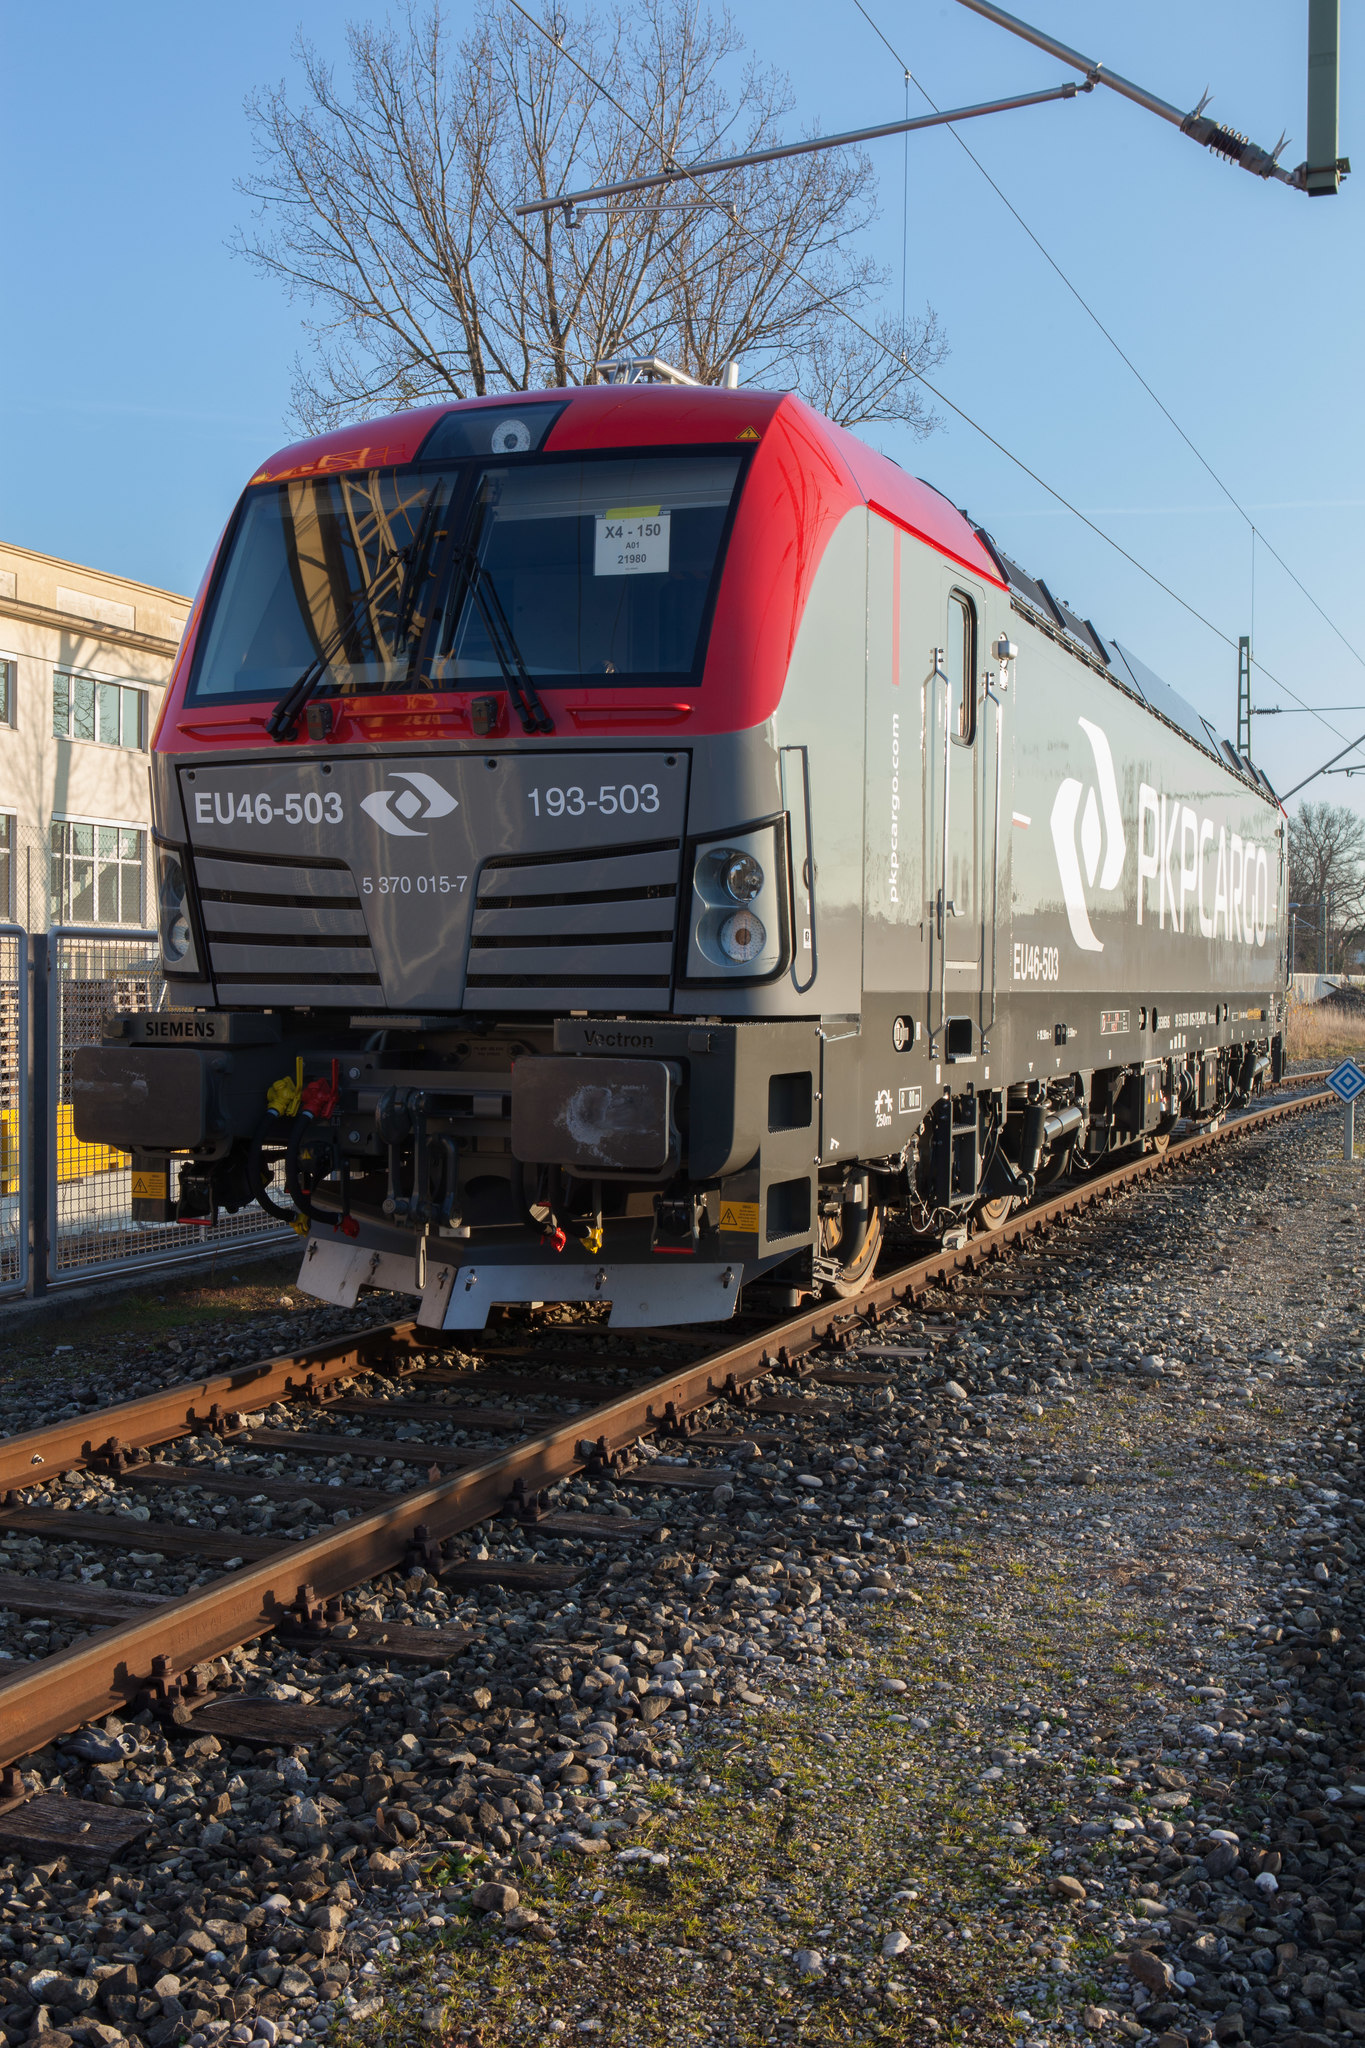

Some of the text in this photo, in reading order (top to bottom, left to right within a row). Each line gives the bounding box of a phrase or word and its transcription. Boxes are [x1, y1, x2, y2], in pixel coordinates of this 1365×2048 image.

[605, 526, 623, 539] X4
[637, 523, 661, 537] 150
[625, 541, 640, 550] A01
[617, 553, 647, 564] 21980
[194, 792, 344, 825] EU46-503
[528, 783, 660, 817] 193-503
[888, 713, 900, 903] pkpcargo.com
[362, 875, 468, 894] 5 370 015-7
[1013, 942, 1059, 982] EU46-503
[145, 1021, 215, 1037] SIEMENS
[583, 1029, 654, 1048] Vectron
